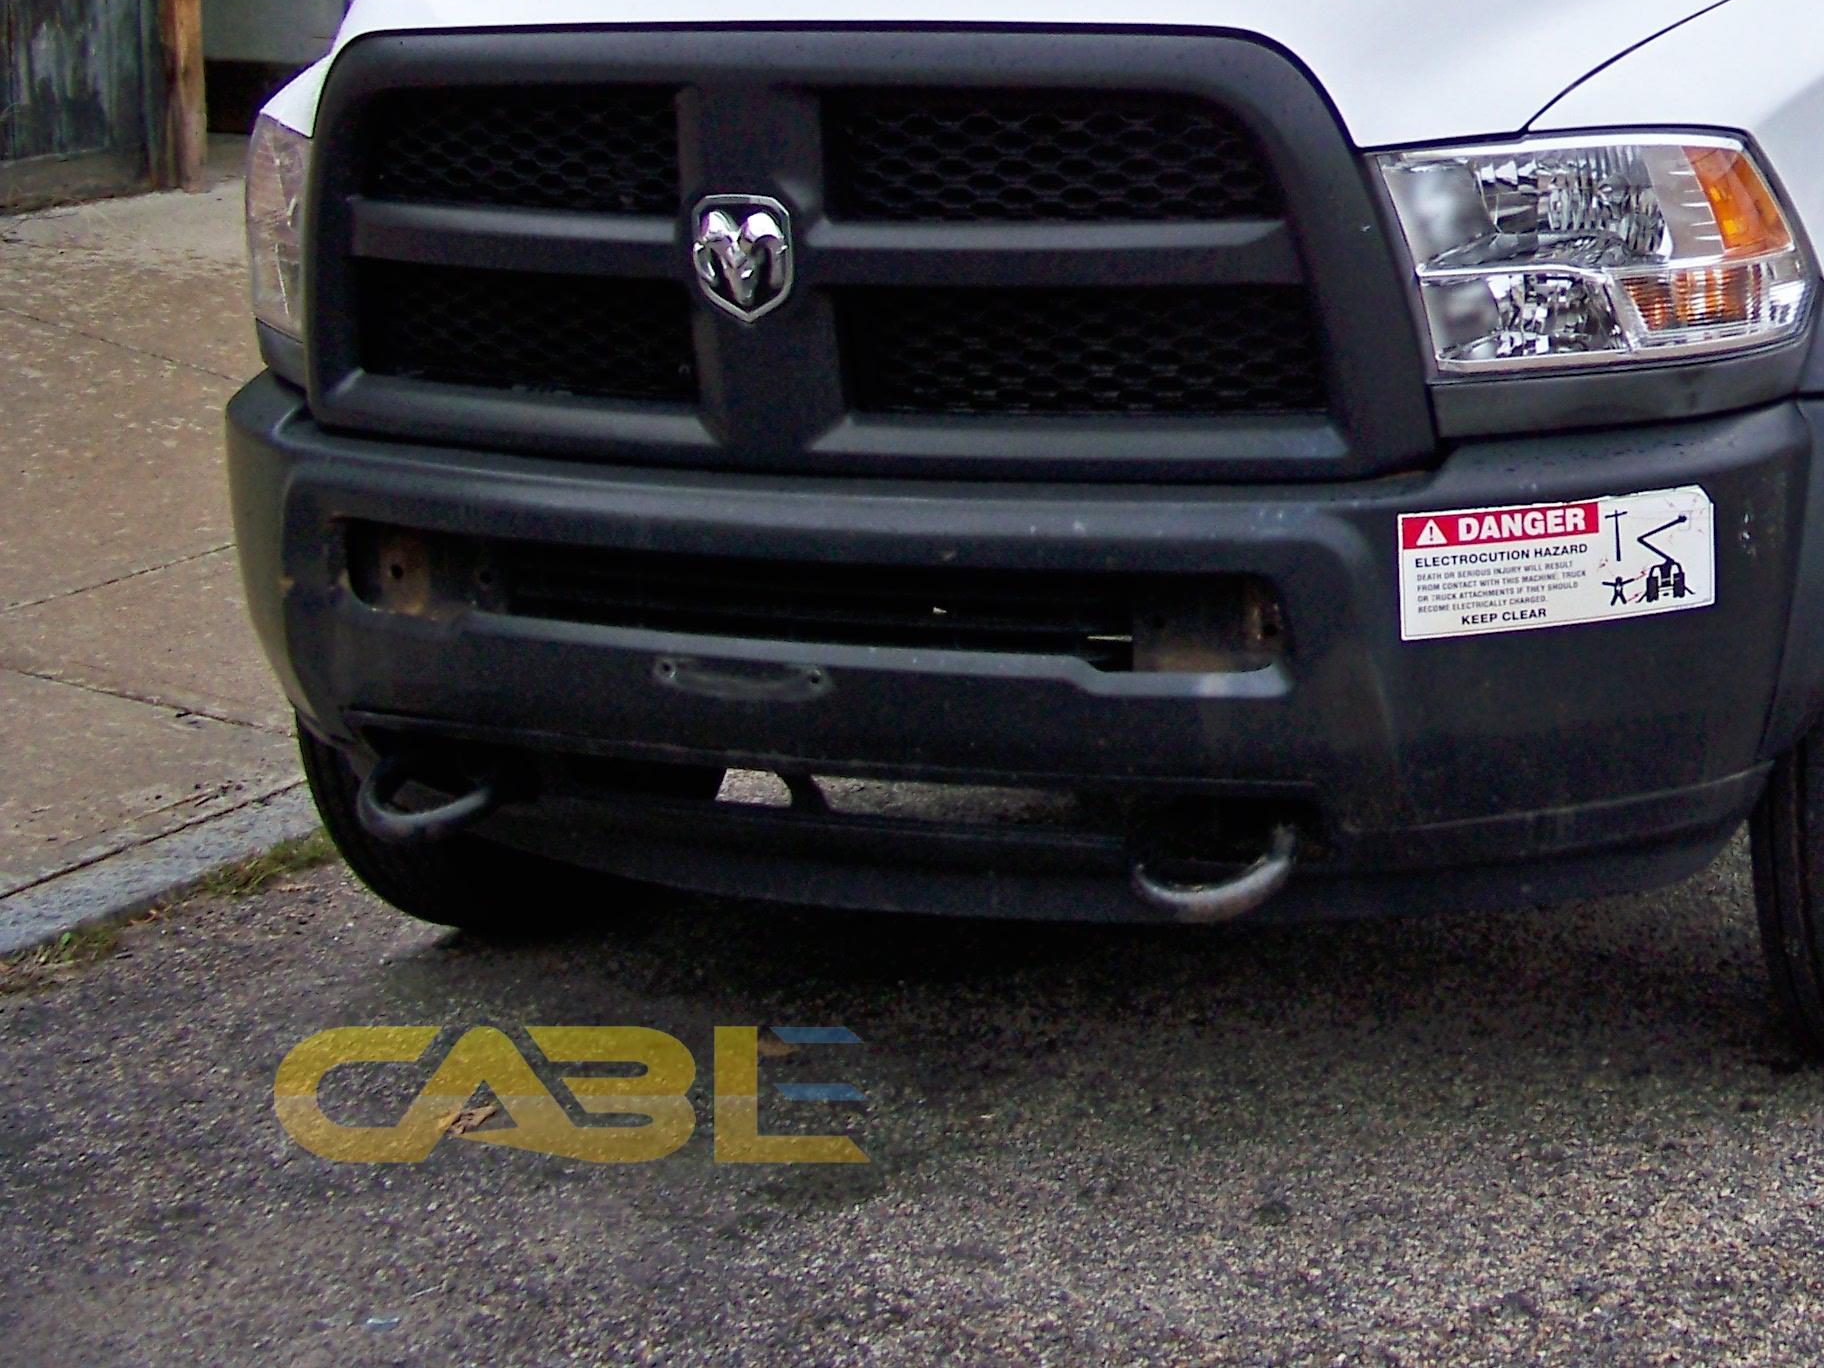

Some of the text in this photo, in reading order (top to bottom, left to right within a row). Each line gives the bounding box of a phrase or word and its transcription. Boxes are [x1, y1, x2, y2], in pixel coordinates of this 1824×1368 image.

[1457, 507, 1586, 542] DANGER
[1415, 543, 1588, 568] ELECTROCUTION HAZARD
[1417, 561, 1573, 582] DEATH OR SERIOUS INJURY WILL RESULT
[1417, 584, 1440, 592] FROM
[1442, 580, 1477, 590] CONTACT
[1479, 578, 1500, 587] WITH
[1502, 576, 1520, 585] THIS
[1562, 570, 1586, 579] TRUCK
[1417, 595, 1429, 603] OR
[1459, 587, 1515, 599] ATTACHMENTS
[1516, 586, 1523, 594] IF
[1526, 584, 1545, 593] THEY
[1547, 581, 1578, 591] SHOULD
[1418, 604, 1449, 614] BECOME
[1452, 599, 1507, 611] ELECTRICALLY
[1461, 608, 1547, 625] KEEP CLEAR
